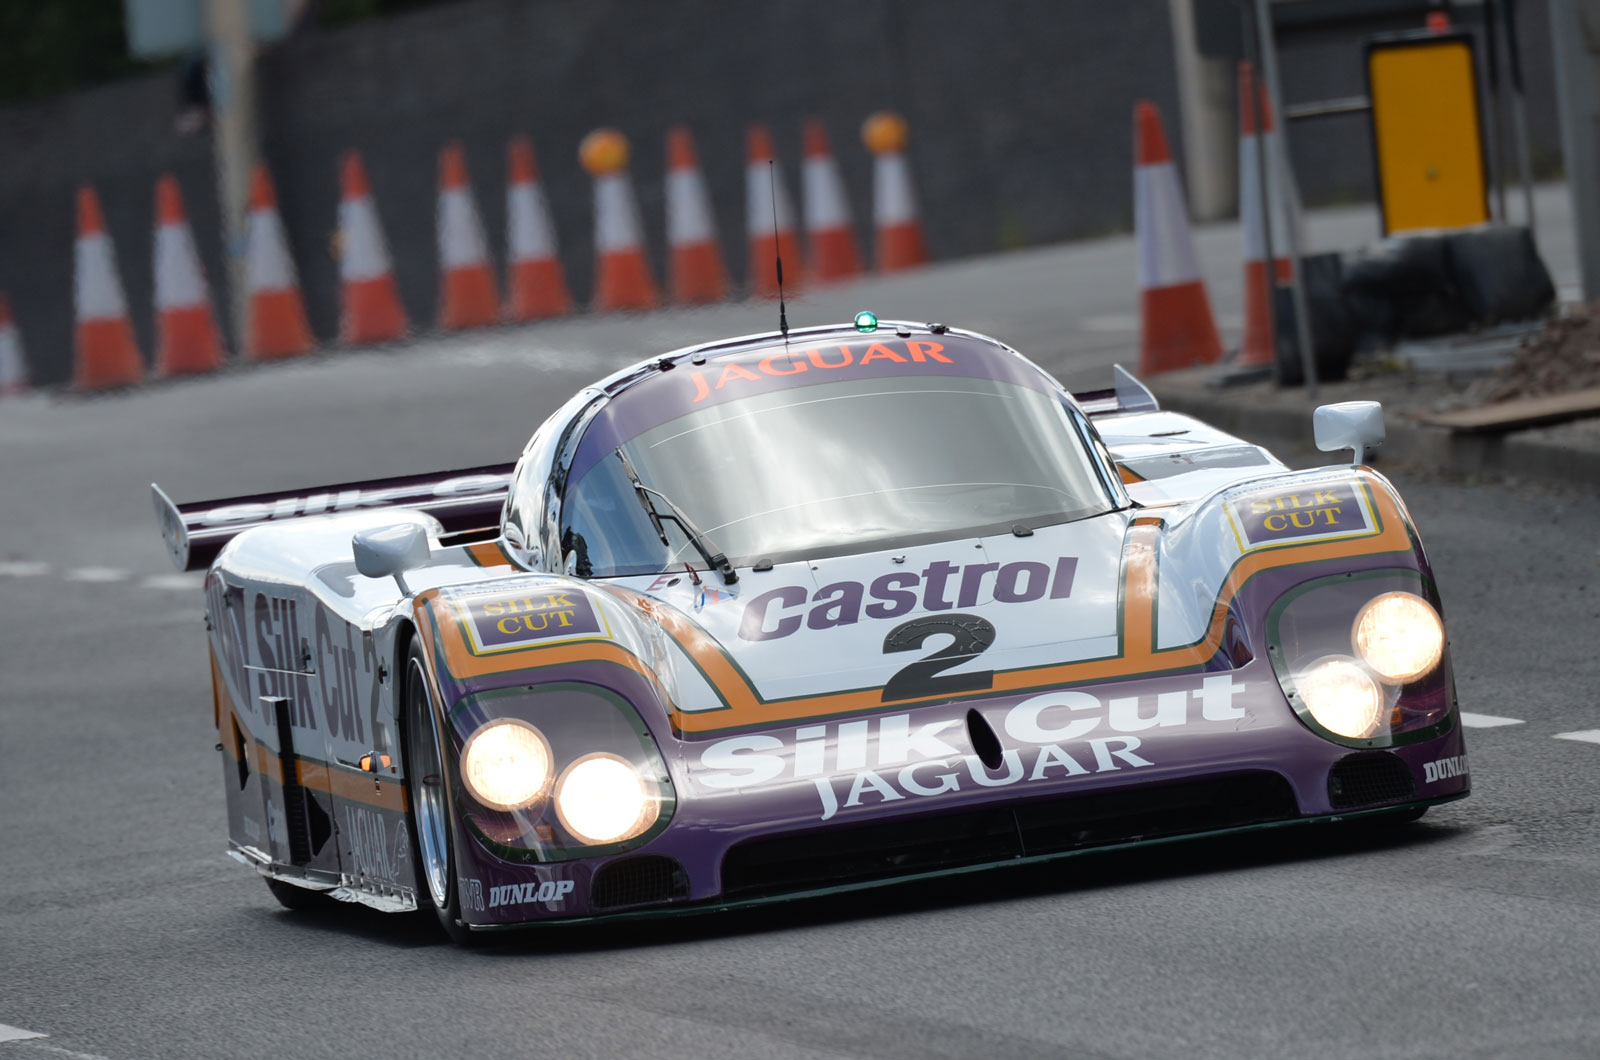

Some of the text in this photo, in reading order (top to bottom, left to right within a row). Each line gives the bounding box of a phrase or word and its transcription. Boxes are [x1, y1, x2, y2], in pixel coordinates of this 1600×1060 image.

[689, 341, 954, 403] JAGUAR
[1249, 489, 1343, 514] SILK
[1263, 507, 1342, 532] CUT
[482, 592, 577, 617] SILK
[738, 557, 1079, 641] Castrol
[497, 610, 575, 635] CUT
[315, 600, 365, 745] Cut
[881, 613, 997, 703] 2
[700, 674, 1248, 789] Silk Cut
[807, 734, 1156, 821] JAGUAR
[1423, 754, 1469, 784] DUNLO
[488, 880, 575, 908] DUNLOP
